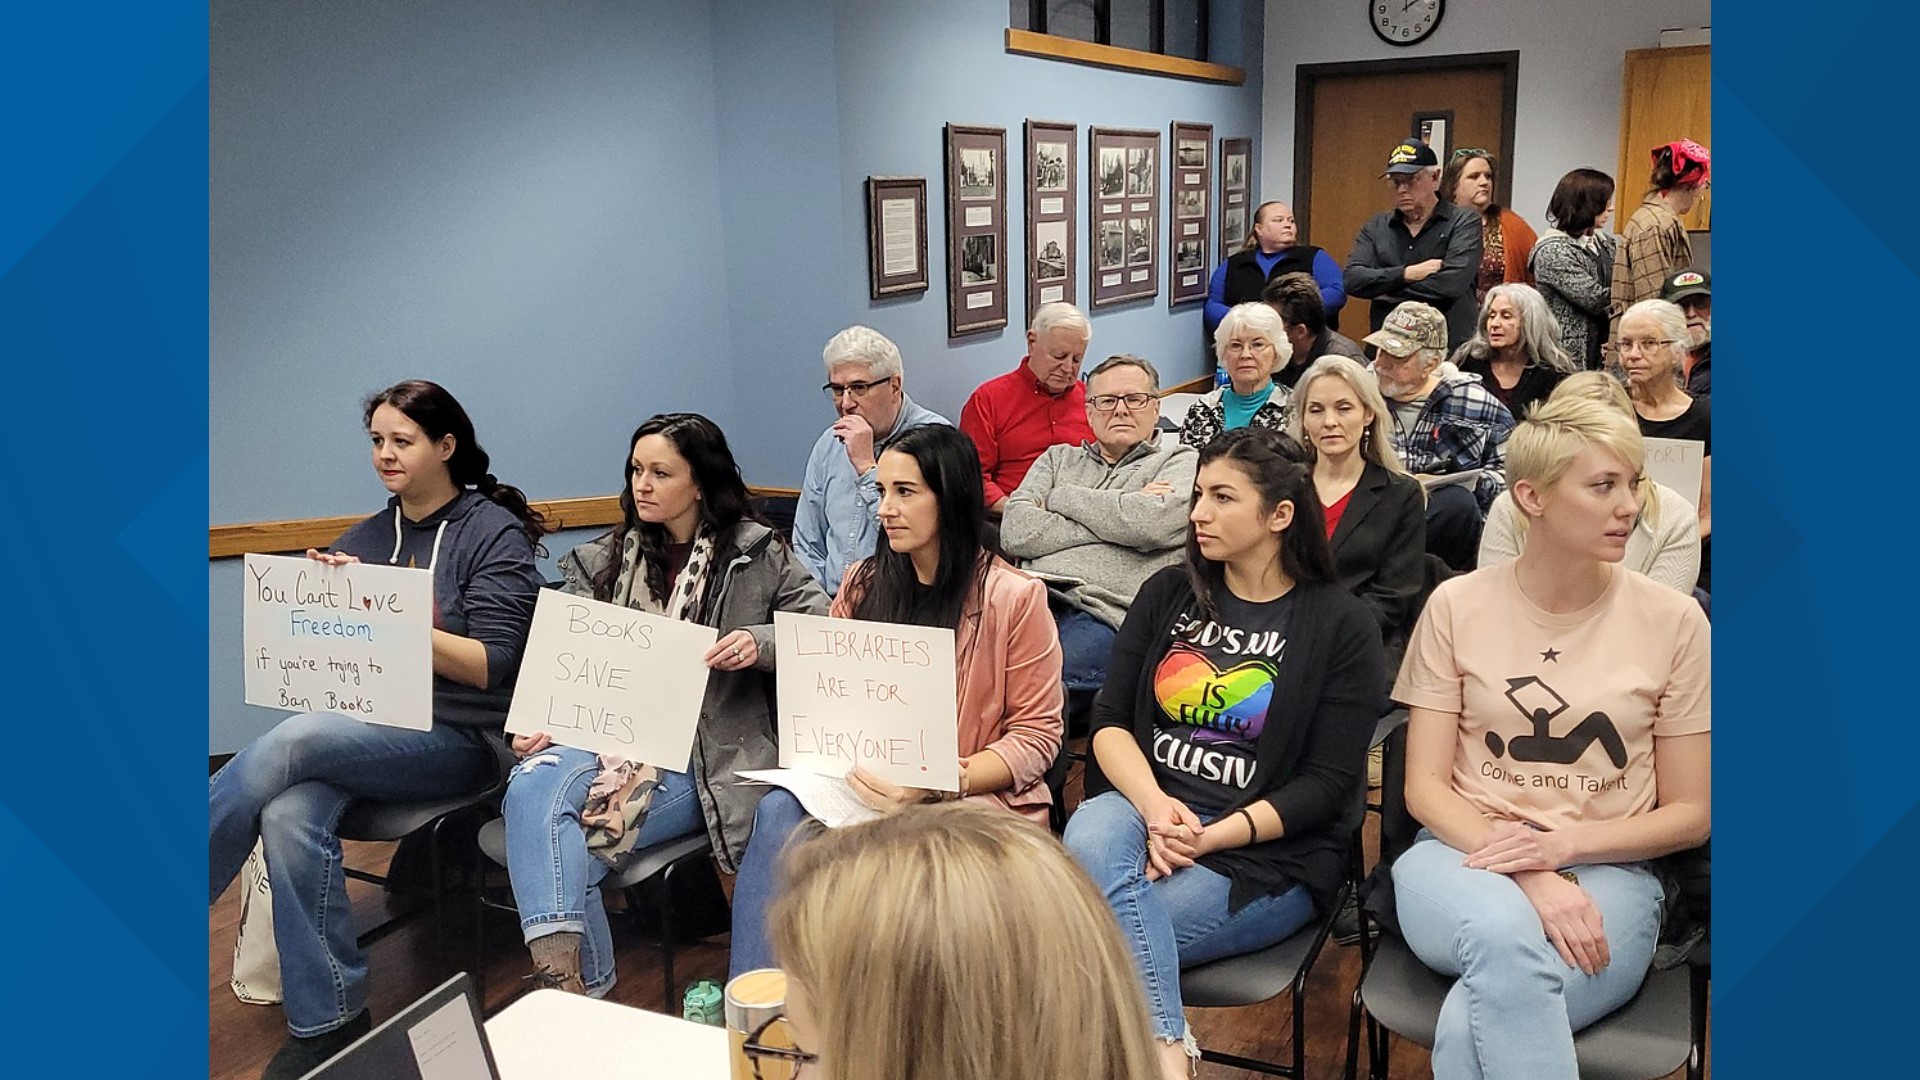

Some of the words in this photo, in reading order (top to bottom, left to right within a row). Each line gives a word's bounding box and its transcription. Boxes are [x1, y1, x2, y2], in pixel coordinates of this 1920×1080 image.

[1402, 27, 1410, 37] 6
[249, 563, 288, 605] You
[290, 609, 373, 641] Freedom
[566, 603, 653, 651] BOOKS
[794, 623, 931, 668] LIBRARIES
[255, 646, 271, 670] if
[278, 655, 318, 687] you're
[327, 656, 361, 687] trying
[367, 657, 383, 674] to
[554, 651, 631, 692] SAVE
[277, 687, 313, 712] Ban
[324, 691, 374, 714] Books
[815, 671, 849, 699] ARE
[864, 679, 908, 706] FOR
[1202, 681, 1228, 710] IS
[546, 695, 635, 745] LIVES
[1531, 774, 1569, 790] and
